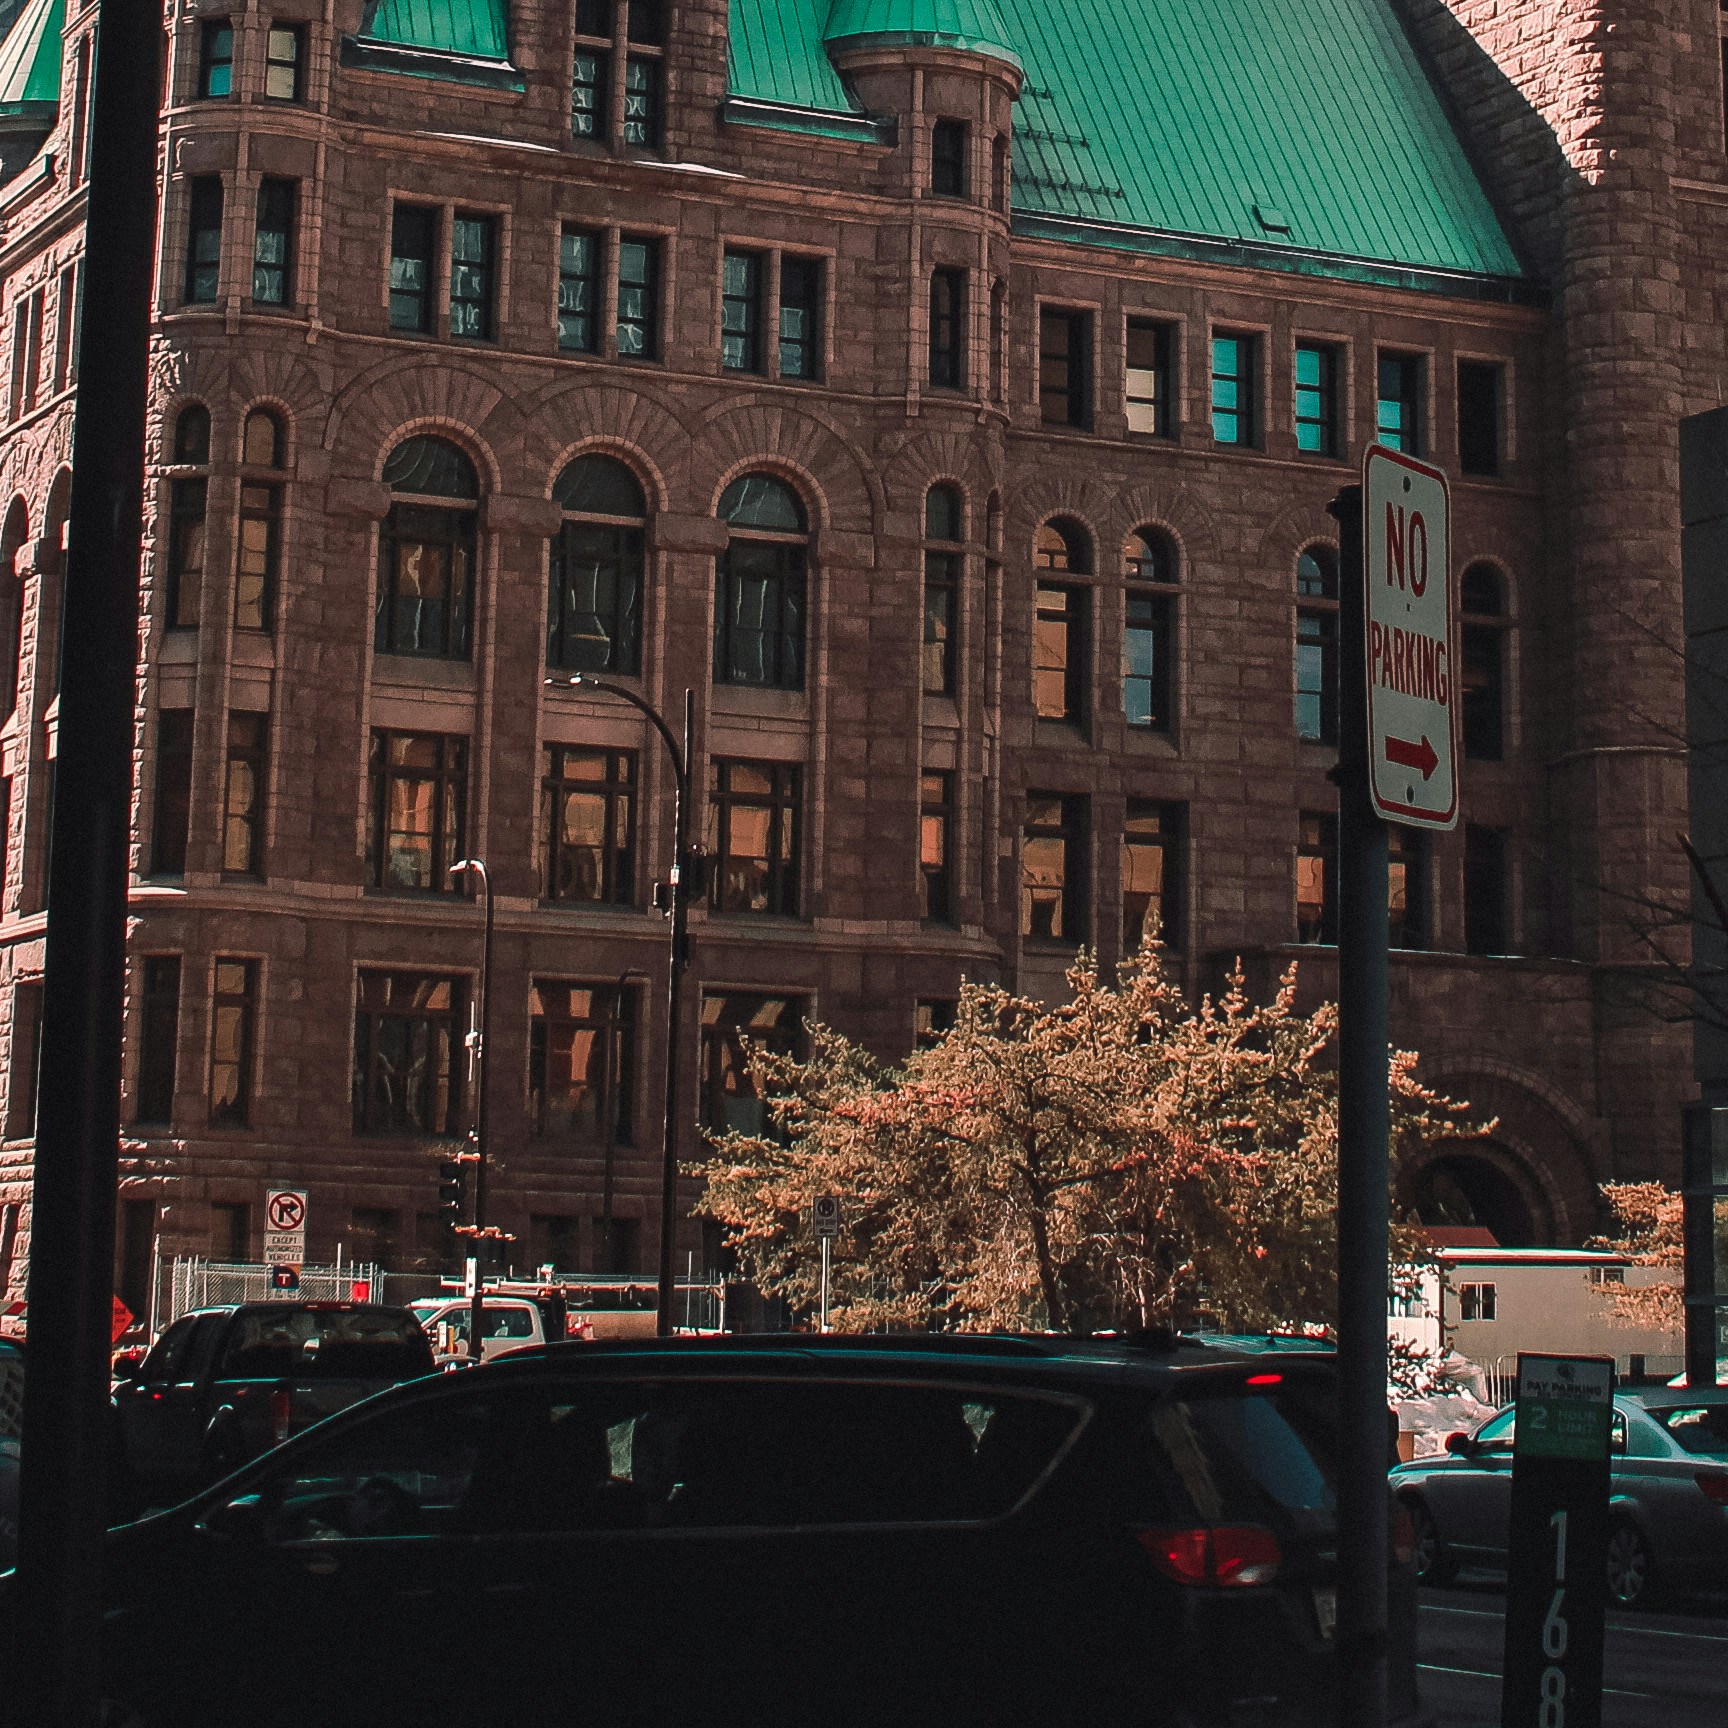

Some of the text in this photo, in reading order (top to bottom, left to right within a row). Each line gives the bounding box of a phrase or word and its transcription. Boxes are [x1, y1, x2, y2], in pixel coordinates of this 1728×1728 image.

[1385, 500, 1428, 598] NO
[1371, 620, 1448, 706] PARKING
[272, 1235, 297, 1244] EXCEPT
[268, 1253, 300, 1262] VEHICLES
[278, 1273, 290, 1284] T
[1526, 1380, 1602, 1395] PAY PARKING
[1530, 1406, 1547, 1429] 2
